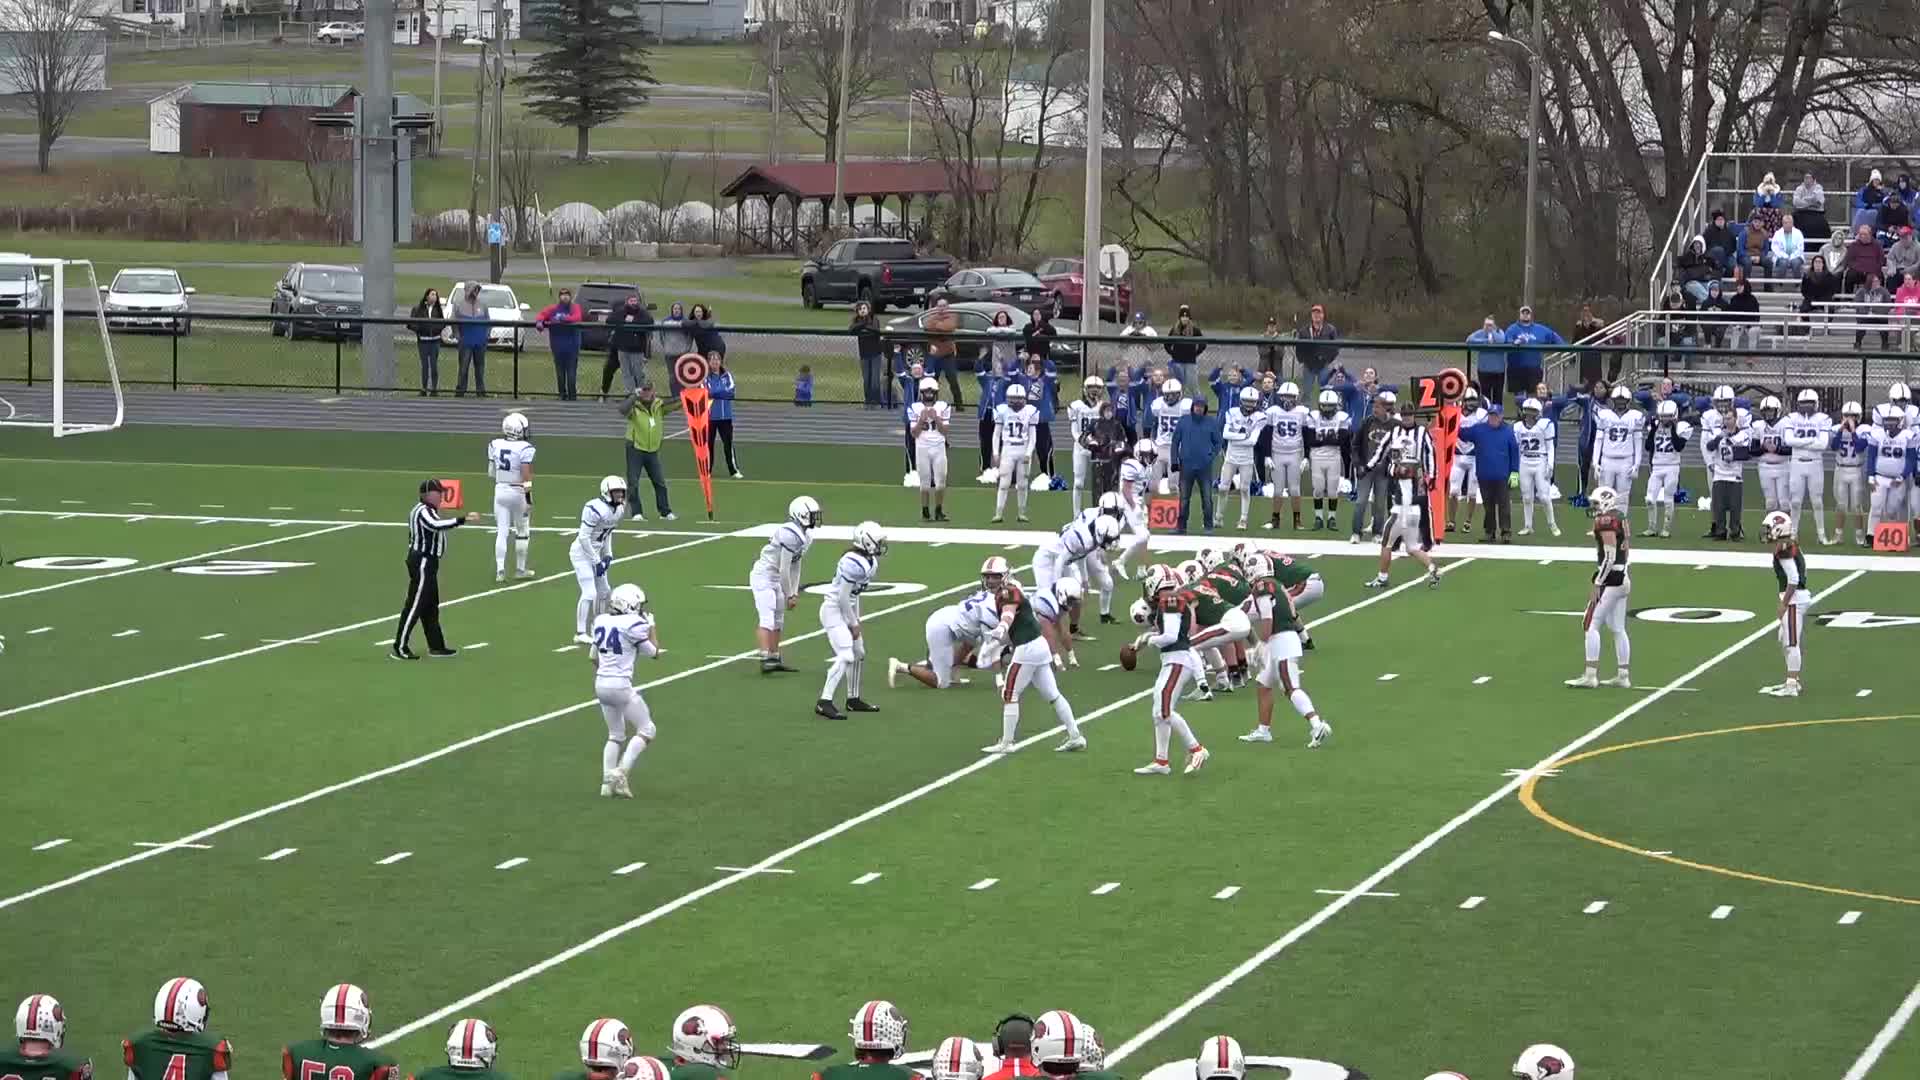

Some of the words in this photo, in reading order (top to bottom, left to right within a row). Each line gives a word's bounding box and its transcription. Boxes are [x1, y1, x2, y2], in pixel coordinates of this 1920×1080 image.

[1419, 378, 1437, 408] 2
[1008, 421, 1024, 439] 17
[1276, 421, 1298, 438] 65
[1608, 428, 1629, 442] 67
[499, 449, 512, 471] 5
[1153, 505, 1177, 525] 30
[1878, 529, 1904, 547] 40
[594, 626, 622, 654] 24
[162, 1054, 186, 1080] 4
